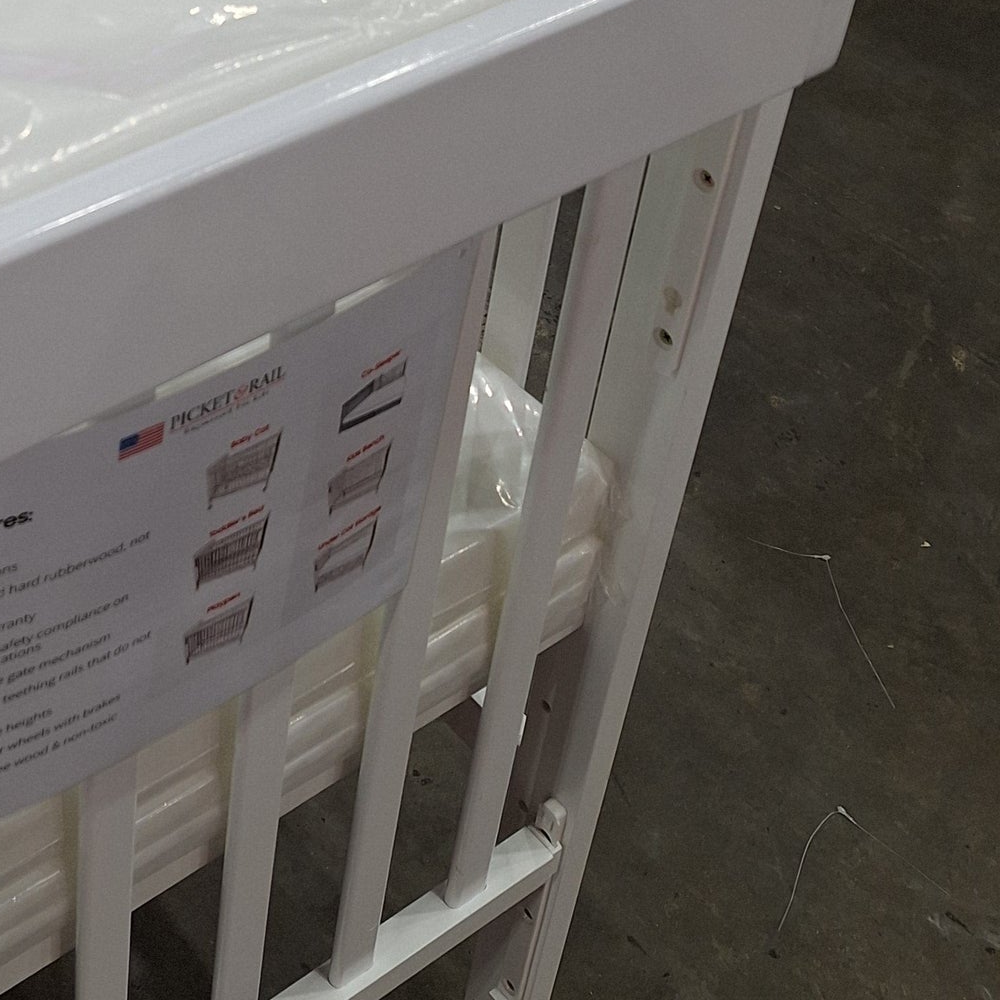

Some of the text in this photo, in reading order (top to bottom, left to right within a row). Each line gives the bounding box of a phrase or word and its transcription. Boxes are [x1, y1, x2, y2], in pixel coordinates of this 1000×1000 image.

[9, 576, 41, 595] hard
[129, 530, 152, 548] not
[36, 601, 112, 640] compliance
[112, 592, 130, 607] on
[2, 675, 57, 704] teething
[58, 663, 85, 683] rails
[86, 651, 112, 670] that
[113, 640, 130, 657] do
[131, 629, 152, 647] not
[6, 664, 36, 685] gate
[38, 632, 112, 671] mechanism
[5, 707, 54, 734] heights
[6, 728, 52, 751] wheels
[53, 713, 81, 733] with
[82, 694, 122, 720] brakes
[13, 748, 51, 768] wood
[62, 711, 118, 747] non-toxic
